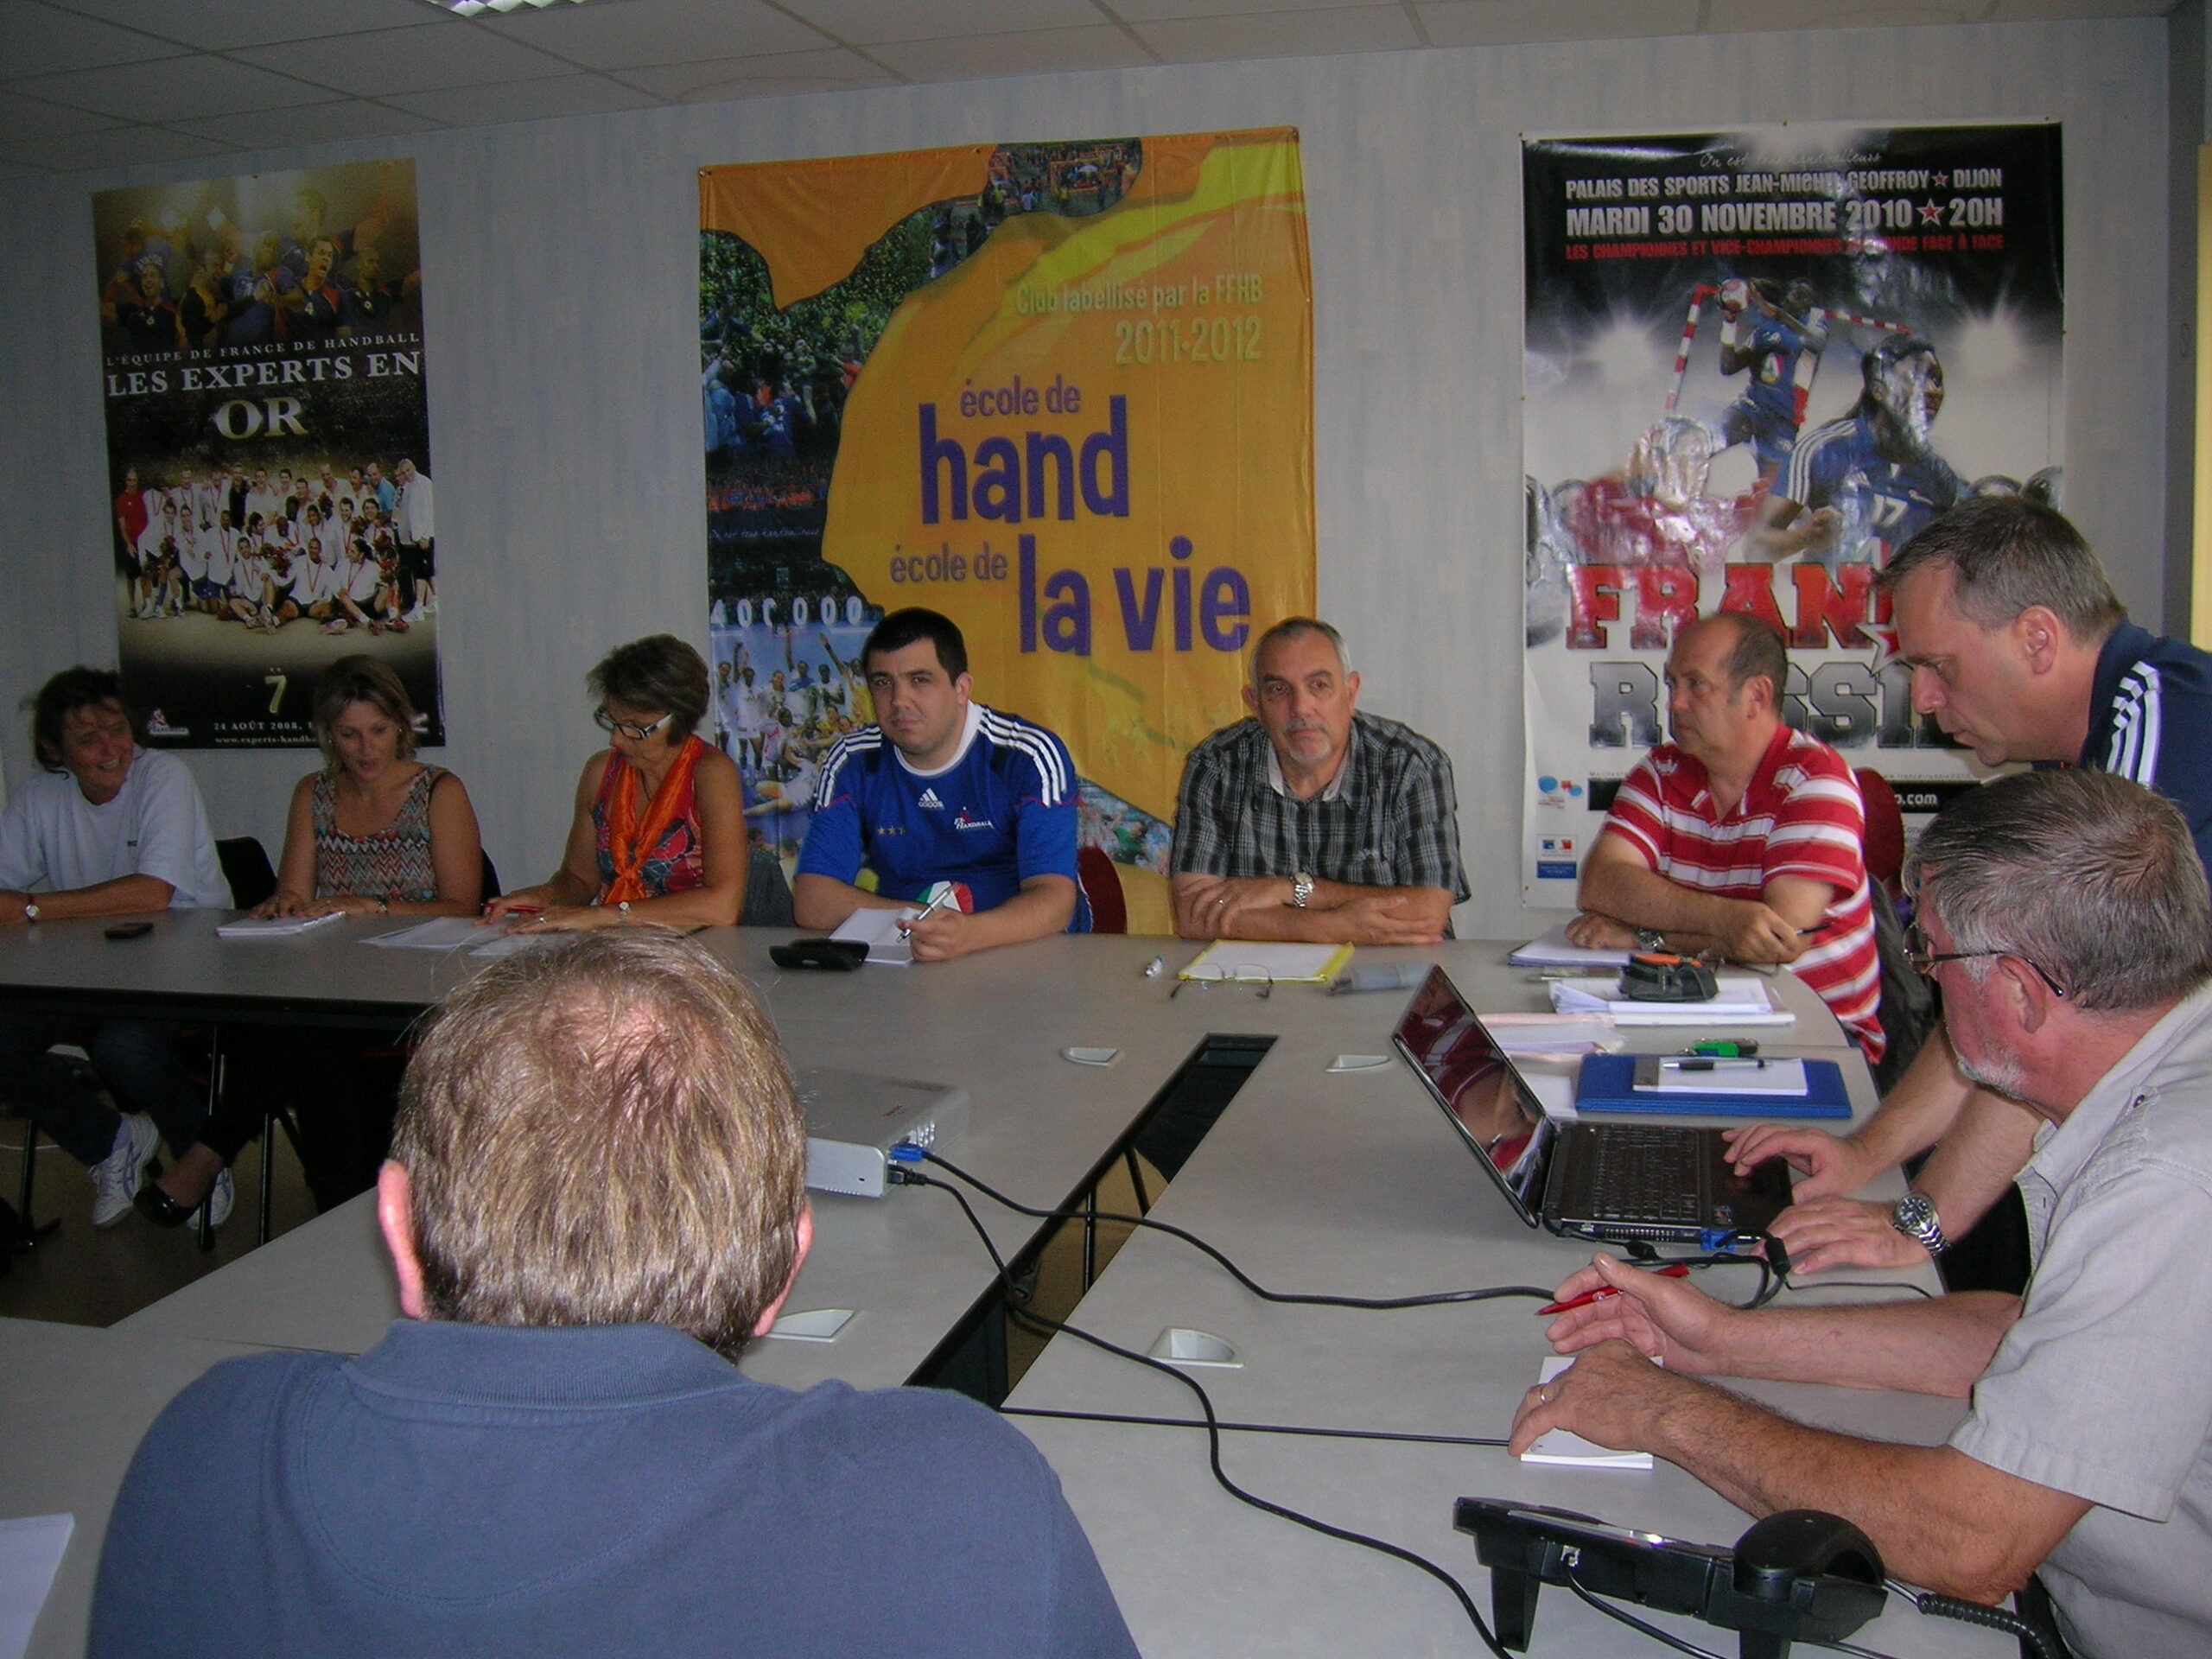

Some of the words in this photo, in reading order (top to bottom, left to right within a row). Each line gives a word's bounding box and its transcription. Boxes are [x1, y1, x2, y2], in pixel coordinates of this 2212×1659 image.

[1566, 178, 1623, 200] PALAIS
[1628, 177, 1659, 198] DES
[1664, 175, 1729, 197] SPORTS
[1847, 169, 1930, 192] GEOFFROY
[1953, 168, 2002, 188] DIJON
[1567, 206, 1649, 236] MARDI
[1657, 204, 1693, 234] 30
[1701, 201, 1837, 232] NOVEMBRE
[1846, 199, 1913, 231] 2010
[1949, 197, 2003, 226] 20H
[1565, 244, 1588, 259] LES
[1592, 240, 1687, 258] CHAMPIONNES
[1692, 240, 1707, 256] ET
[1923, 234, 1954, 250] FACE
[1973, 233, 2004, 250] FACE
[1015, 285, 1058, 315] Club
[1153, 283, 1185, 313] par
[1192, 276, 1210, 306] la
[1215, 273, 1262, 304] FFHB
[191, 348, 212, 360] DE
[220, 343, 285, 357] FRANCE
[294, 340, 315, 352] DE
[325, 332, 420, 349] HANDBALL
[107, 370, 168, 397] LES
[181, 355, 353, 391] EXPERTS
[366, 351, 421, 378] EN
[960, 373, 1039, 417] école
[1046, 372, 1081, 414] de
[212, 397, 308, 441] OR
[918, 393, 1129, 524] hand
[890, 542, 966, 584] école
[974, 541, 1008, 581] de
[1018, 533, 1091, 656] la
[1113, 535, 1251, 652] vie
[1566, 562, 1895, 650] FRAN
[264, 674, 287, 715] 7
[213, 722, 226, 731] 24
